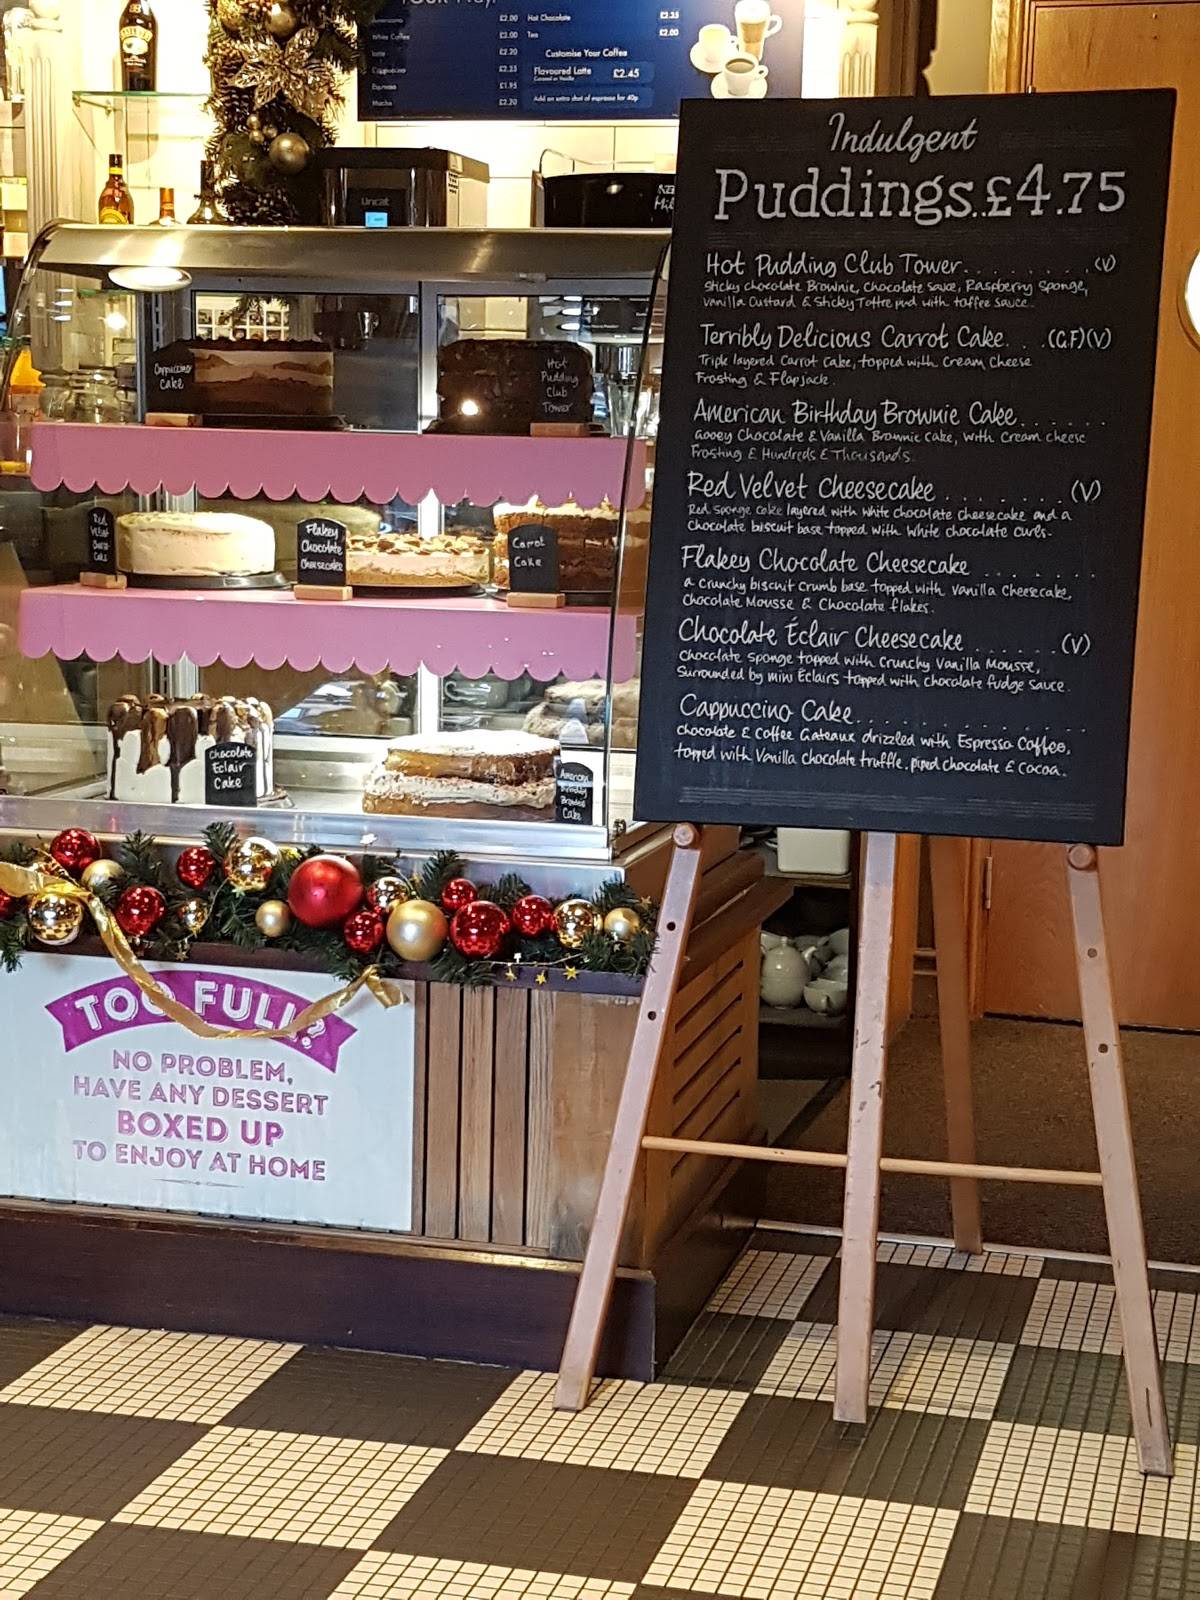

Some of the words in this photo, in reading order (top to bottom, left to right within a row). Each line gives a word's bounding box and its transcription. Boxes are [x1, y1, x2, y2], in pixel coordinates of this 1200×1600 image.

[613, 68, 640, 78] £2.45
[828, 112, 979, 163] Indulgent
[707, 251, 745, 276] Hot
[755, 251, 837, 278] Pudding
[844, 250, 894, 275] Club
[966, 279, 1033, 296] Raspberry
[700, 322, 772, 349] Terribly
[778, 321, 870, 348] Delicious
[881, 322, 949, 348] Carrot
[546, 356, 568, 369] Hot
[733, 354, 775, 370] layered
[858, 354, 904, 370] topped
[541, 370, 579, 388] Pudding
[696, 371, 748, 389] Frosting
[546, 385, 567, 397] Club
[542, 401, 573, 413] Tower
[693, 398, 785, 424] American
[792, 398, 877, 431] Birthday
[880, 399, 960, 425] Brownie
[737, 427, 804, 442] Chocolate
[820, 427, 865, 442] Vanilla
[963, 429, 995, 444] with
[691, 444, 742, 462] Frosting
[761, 446, 817, 461] Hundreds
[687, 470, 736, 499] Red
[739, 470, 808, 500] Velvet
[818, 473, 936, 501] Cheesecake
[1070, 479, 1101, 503] (V)
[787, 503, 827, 519] layered
[305, 522, 338, 540] Flakey
[751, 519, 794, 534] biscuit
[824, 521, 866, 537] topped
[945, 523, 1008, 538] chocolate
[301, 539, 343, 555] Chocolate
[514, 556, 542, 568] Cake
[681, 543, 750, 573] Flakey
[759, 547, 858, 573] Chocolate
[866, 549, 969, 576] Cheesecake
[750, 576, 795, 591] biscuit
[841, 578, 868, 593] base
[871, 578, 911, 595] topped
[915, 580, 945, 596] with
[678, 614, 777, 646] Chocolate
[785, 616, 848, 648] Éclair
[855, 624, 963, 651] Cheesecake
[1061, 632, 1091, 656] (V)
[797, 650, 840, 667] topped
[844, 652, 875, 668] with
[677, 665, 744, 681] Surrounded
[749, 666, 763, 685] by
[890, 674, 919, 688] with
[987, 674, 1024, 694] fudge
[680, 693, 793, 722] Cappuccino
[921, 732, 951, 749] with
[958, 734, 1014, 752] Espresso
[720, 745, 751, 762] with
[212, 760, 247, 774] Eclair
[214, 776, 242, 790] Cake
[112, 1049, 150, 1072] NO
[161, 1052, 294, 1086] PROBLEM,
[74, 1075, 141, 1100] HAVE
[150, 1082, 205, 1105] ANY
[212, 1086, 328, 1116] DESSERT
[117, 1109, 229, 1144] BOXED
[241, 1120, 285, 1147] UP
[73, 1139, 107, 1161] TO
[116, 1143, 203, 1169] ENJOY
[209, 1151, 241, 1173] AT
[250, 1156, 326, 1181] HOME
